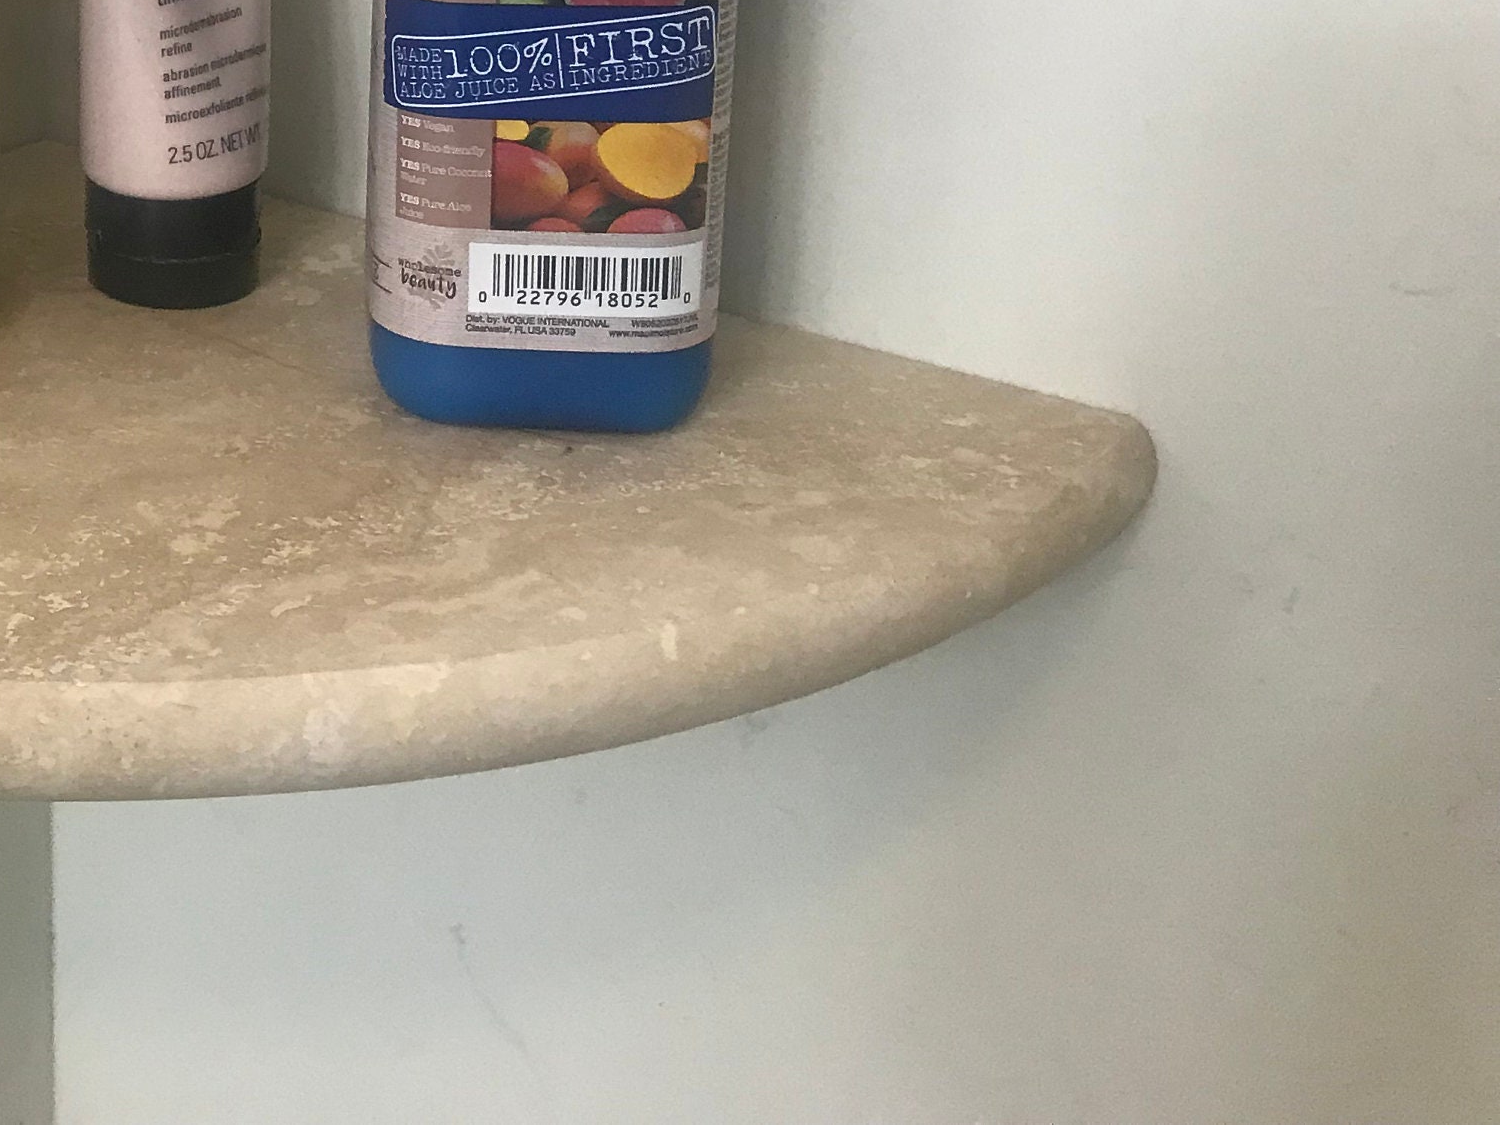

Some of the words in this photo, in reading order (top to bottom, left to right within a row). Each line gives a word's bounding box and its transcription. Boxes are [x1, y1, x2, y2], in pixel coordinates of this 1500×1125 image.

[161, 41, 193, 58] refine
[397, 45, 443, 63] MADE
[444, 37, 553, 79] 100%
[565, 15, 710, 68] FIRST
[163, 62, 209, 83] abrasion
[397, 63, 443, 81] WITH
[400, 78, 446, 100] ALOE
[455, 76, 520, 101] JUICE
[530, 73, 557, 91] AS
[568, 48, 712, 90] INGREDIENT
[164, 76, 222, 100] affinement
[400, 114, 421, 128] YES
[167, 144, 193, 165] 2.5
[220, 129, 244, 154] NET
[400, 136, 421, 150] YES
[400, 158, 420, 171] YES
[421, 162, 446, 175] Pure
[400, 192, 420, 206] YES
[421, 197, 445, 210] Pure
[398, 257, 462, 278] wholesome
[401, 267, 457, 300] beauty
[478, 291, 488, 303] 0
[516, 290, 582, 307] 22796
[596, 292, 659, 308] 18052
[683, 292, 692, 304] 0
[502, 316, 536, 326] VOGUE
[537, 317, 610, 328] INTERNATIONAL
[514, 325, 526, 335] FL
[528, 326, 548, 335] USA
